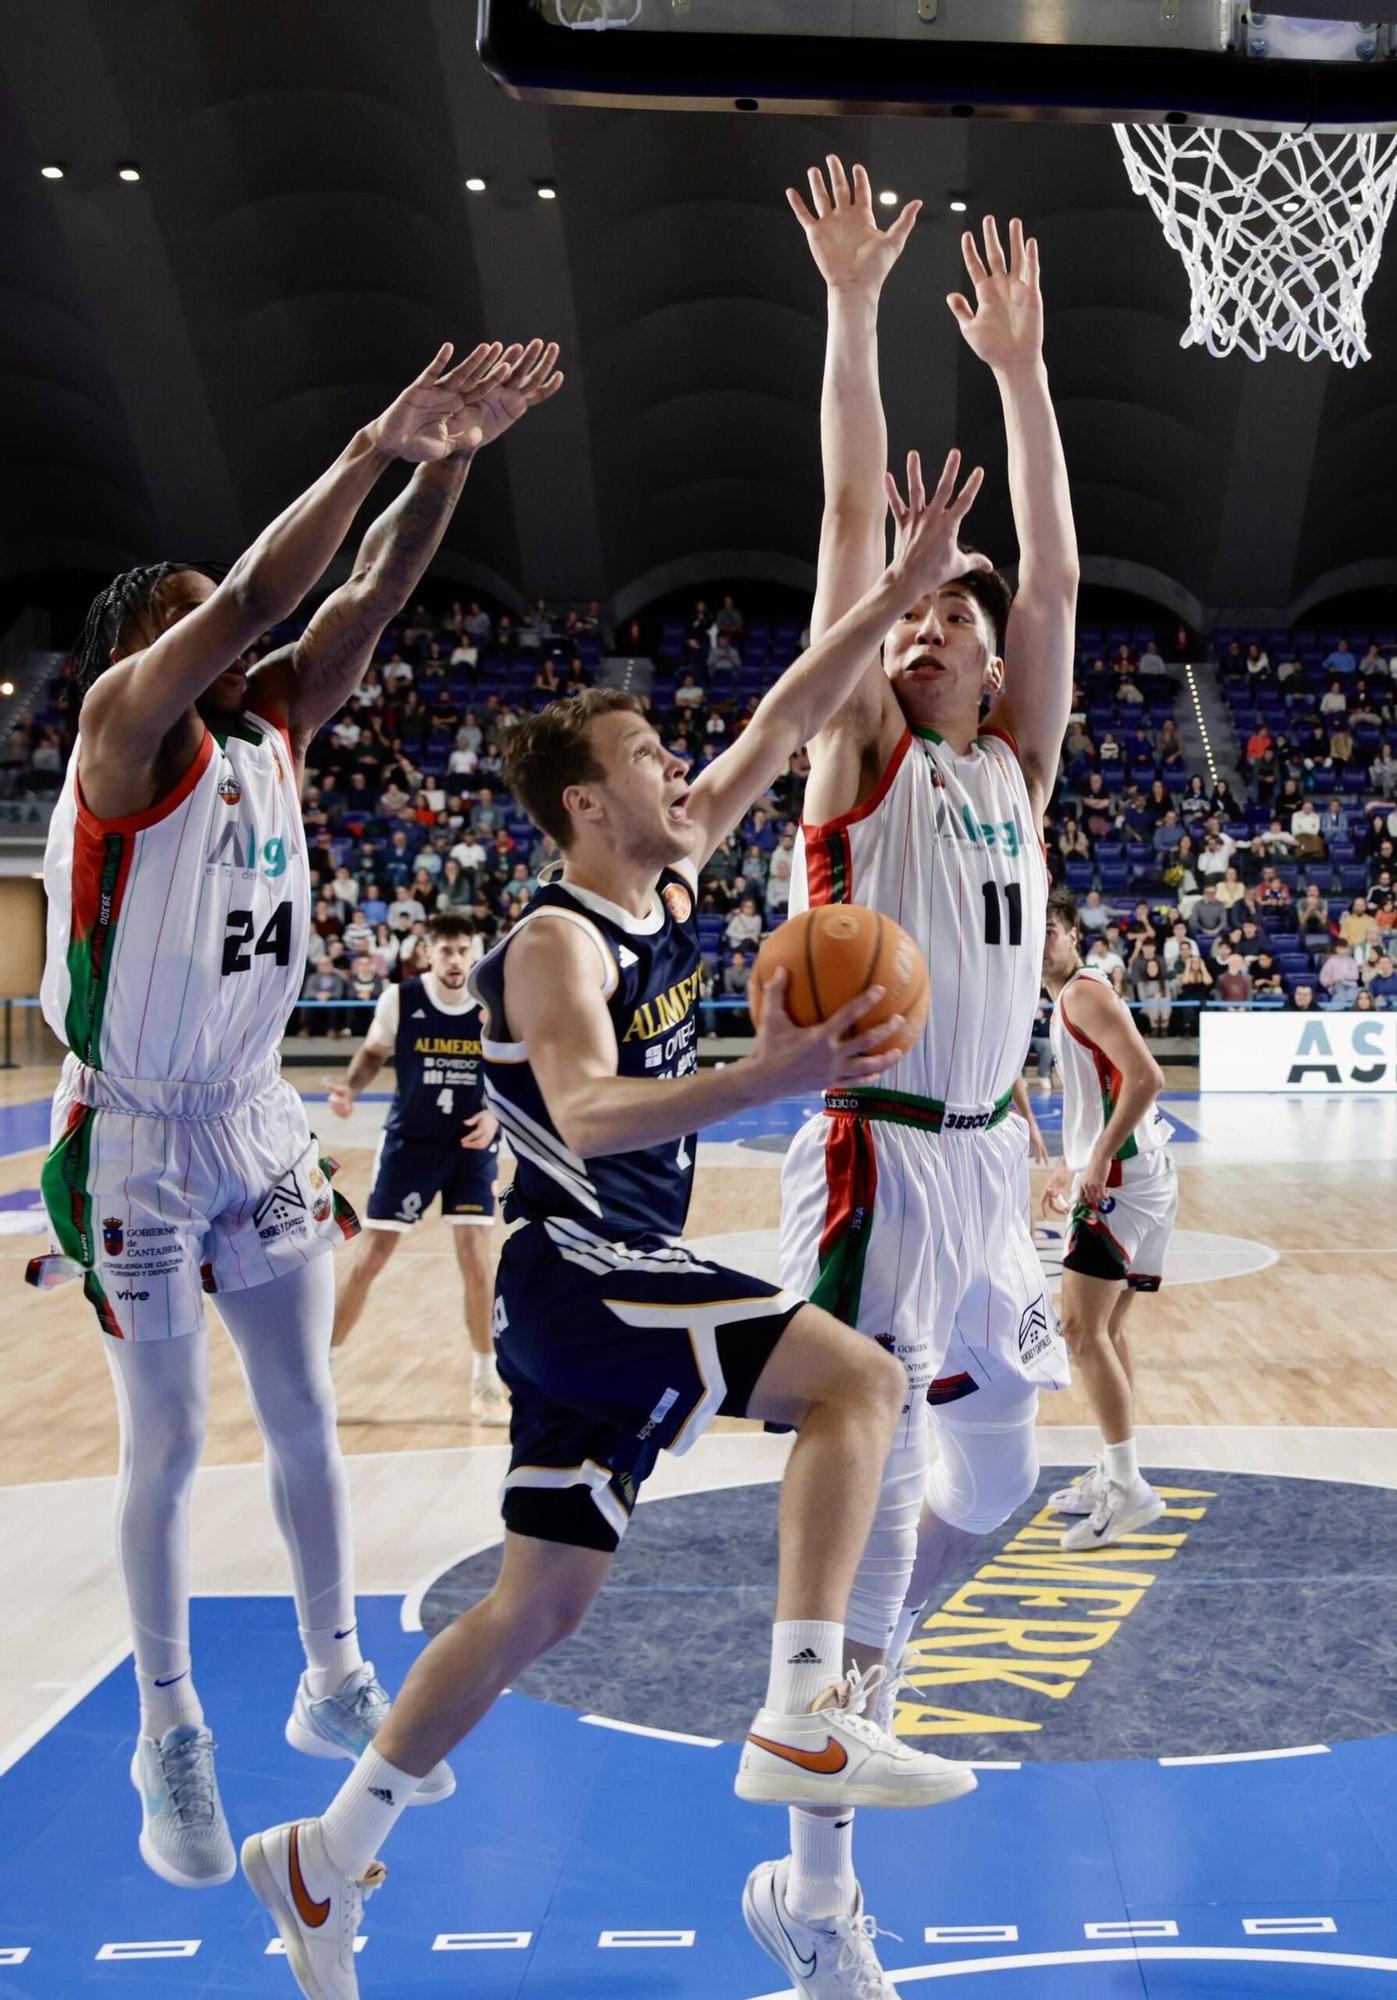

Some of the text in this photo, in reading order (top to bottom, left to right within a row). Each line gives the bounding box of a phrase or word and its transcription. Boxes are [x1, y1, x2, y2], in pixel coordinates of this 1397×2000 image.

[101, 894, 111, 926] 39300
[982, 881, 1022, 946] 11
[221, 901, 293, 976] 24
[1286, 1020, 1397, 1083] AS
[436, 1088, 454, 1114] 4
[127, 1226, 179, 1237] GOBIERNO
[127, 1245, 183, 1257] CANTABRIA
[116, 1289, 150, 1301] vive
